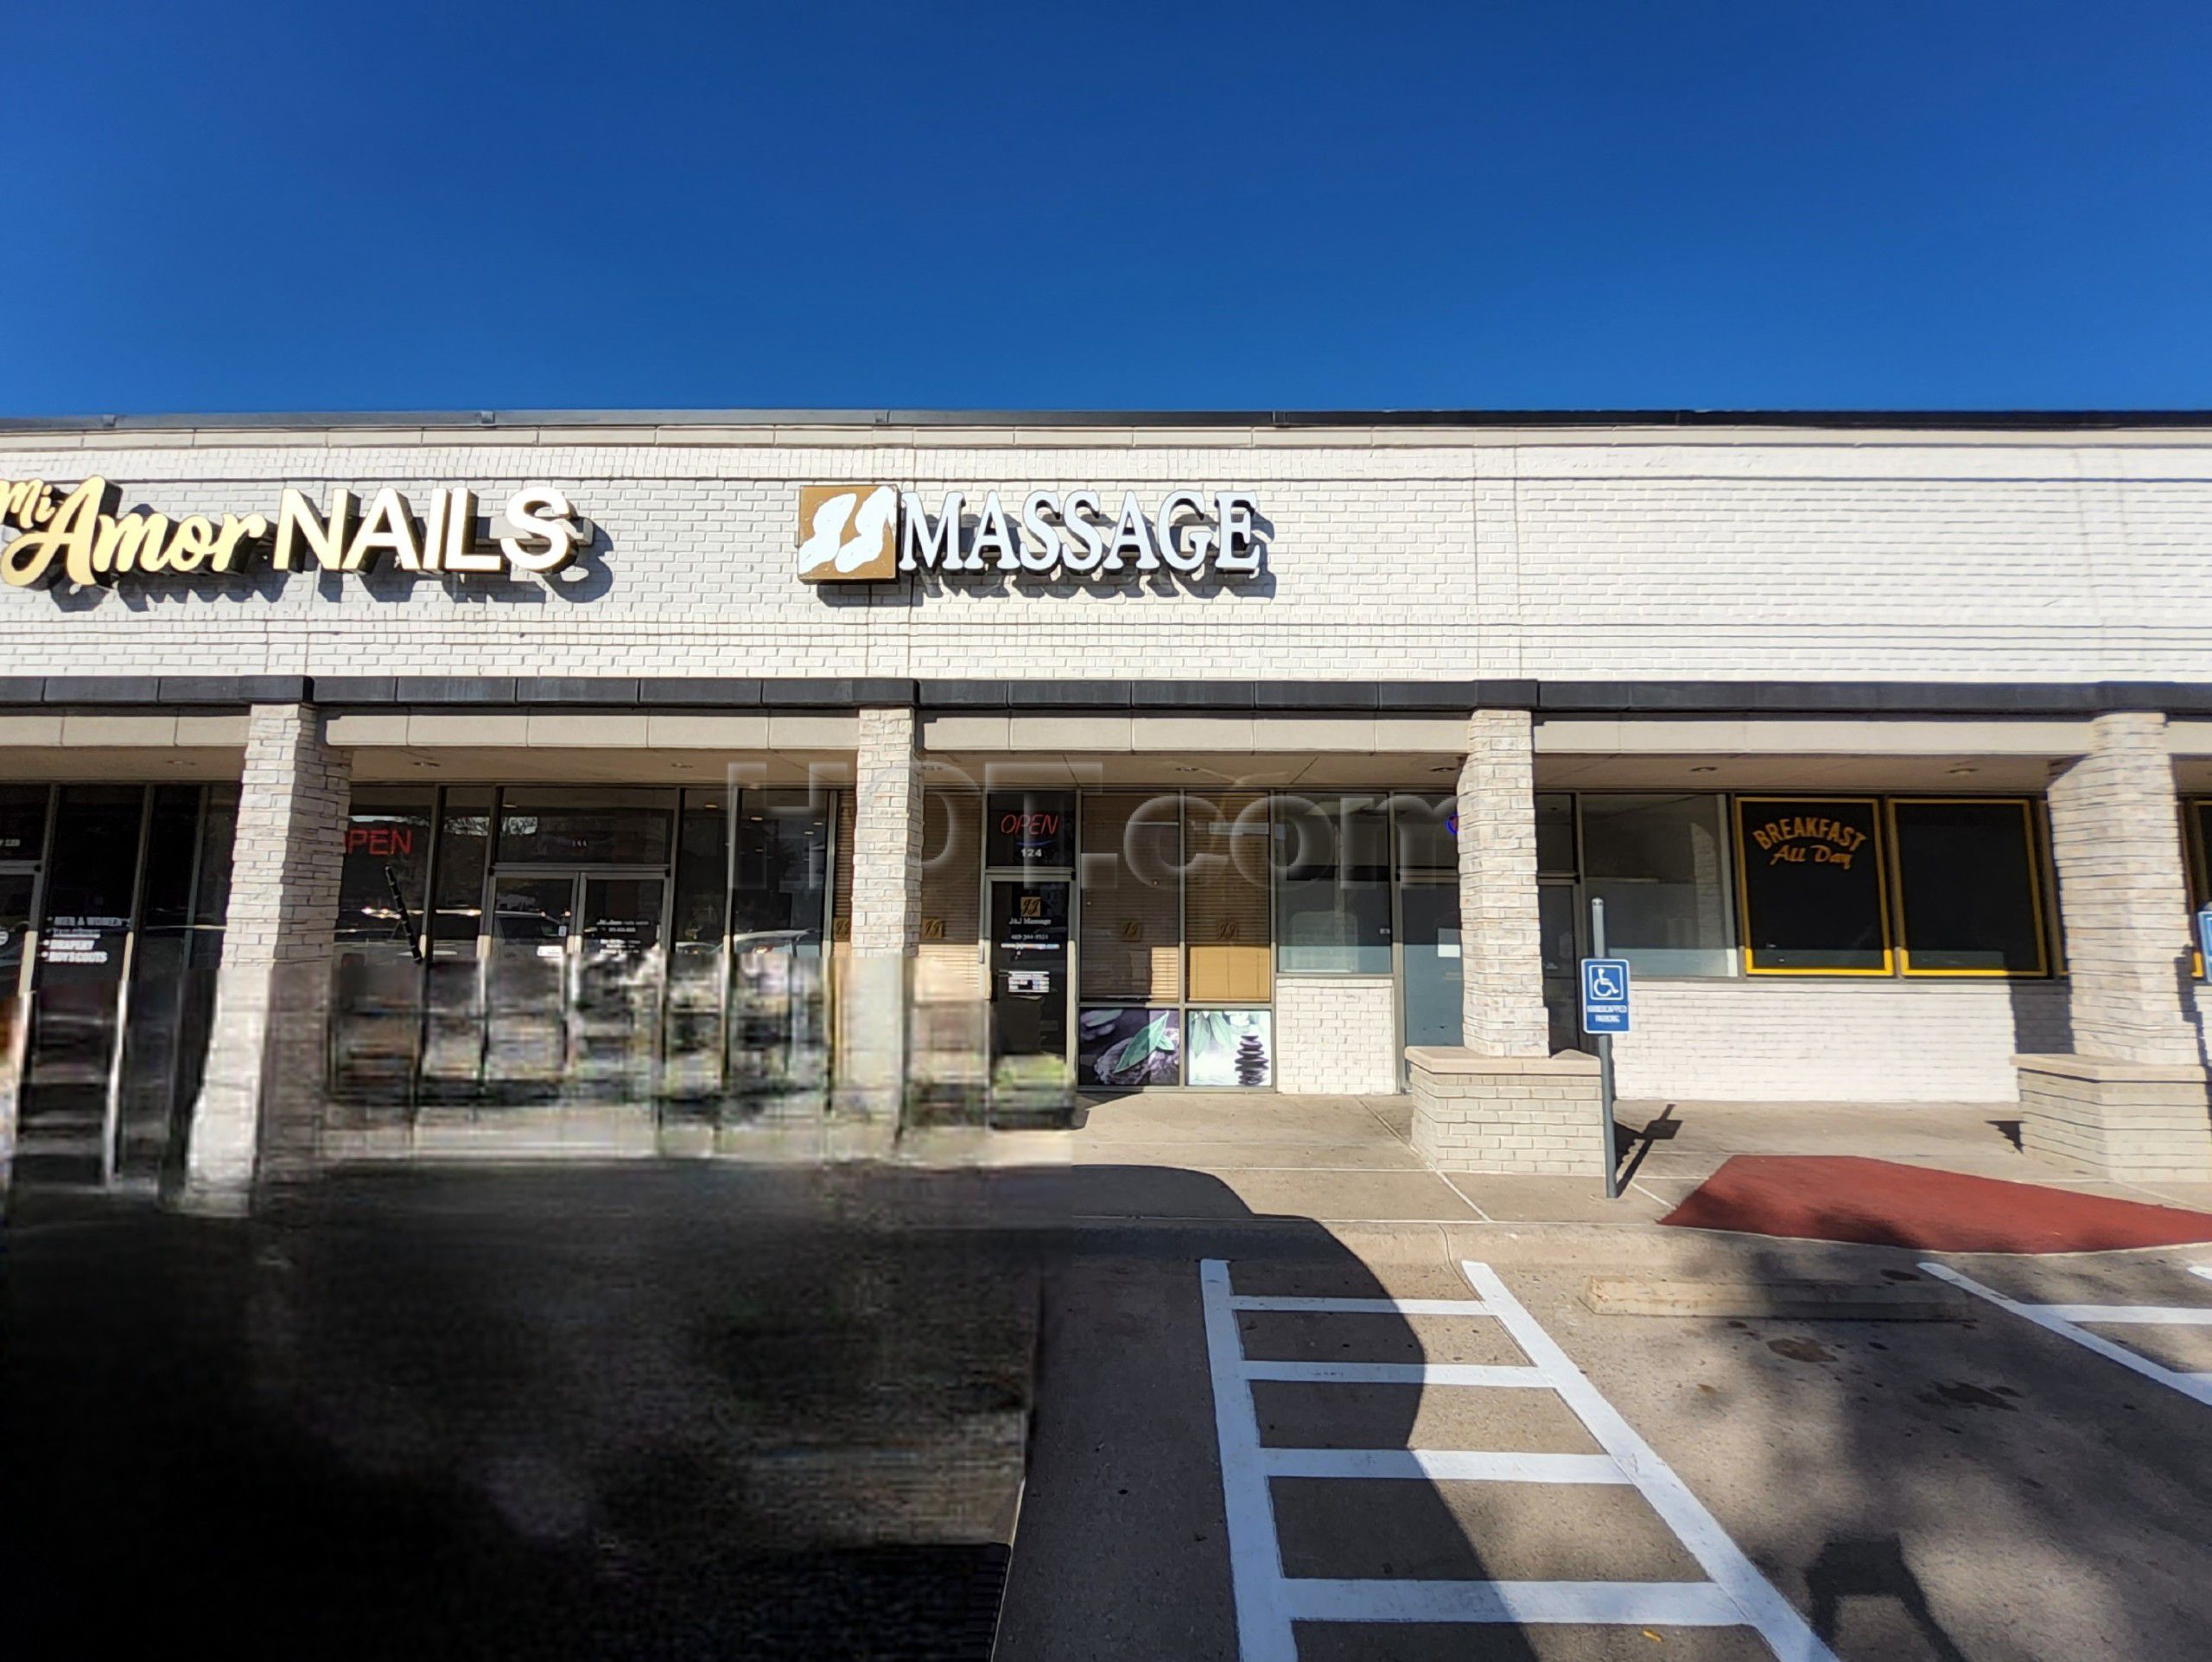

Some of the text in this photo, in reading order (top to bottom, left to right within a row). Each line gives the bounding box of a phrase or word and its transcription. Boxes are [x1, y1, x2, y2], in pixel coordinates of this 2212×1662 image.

[0, 474, 267, 587] Amor
[272, 486, 570, 571] NAILS
[899, 489, 1262, 572] MASSAGE
[1001, 814, 1059, 835] OPEN
[1752, 817, 1867, 850] BREAKFAST
[343, 828, 413, 855] PEN
[1020, 848, 1043, 857] 124
[1770, 844, 1853, 869] All Day
